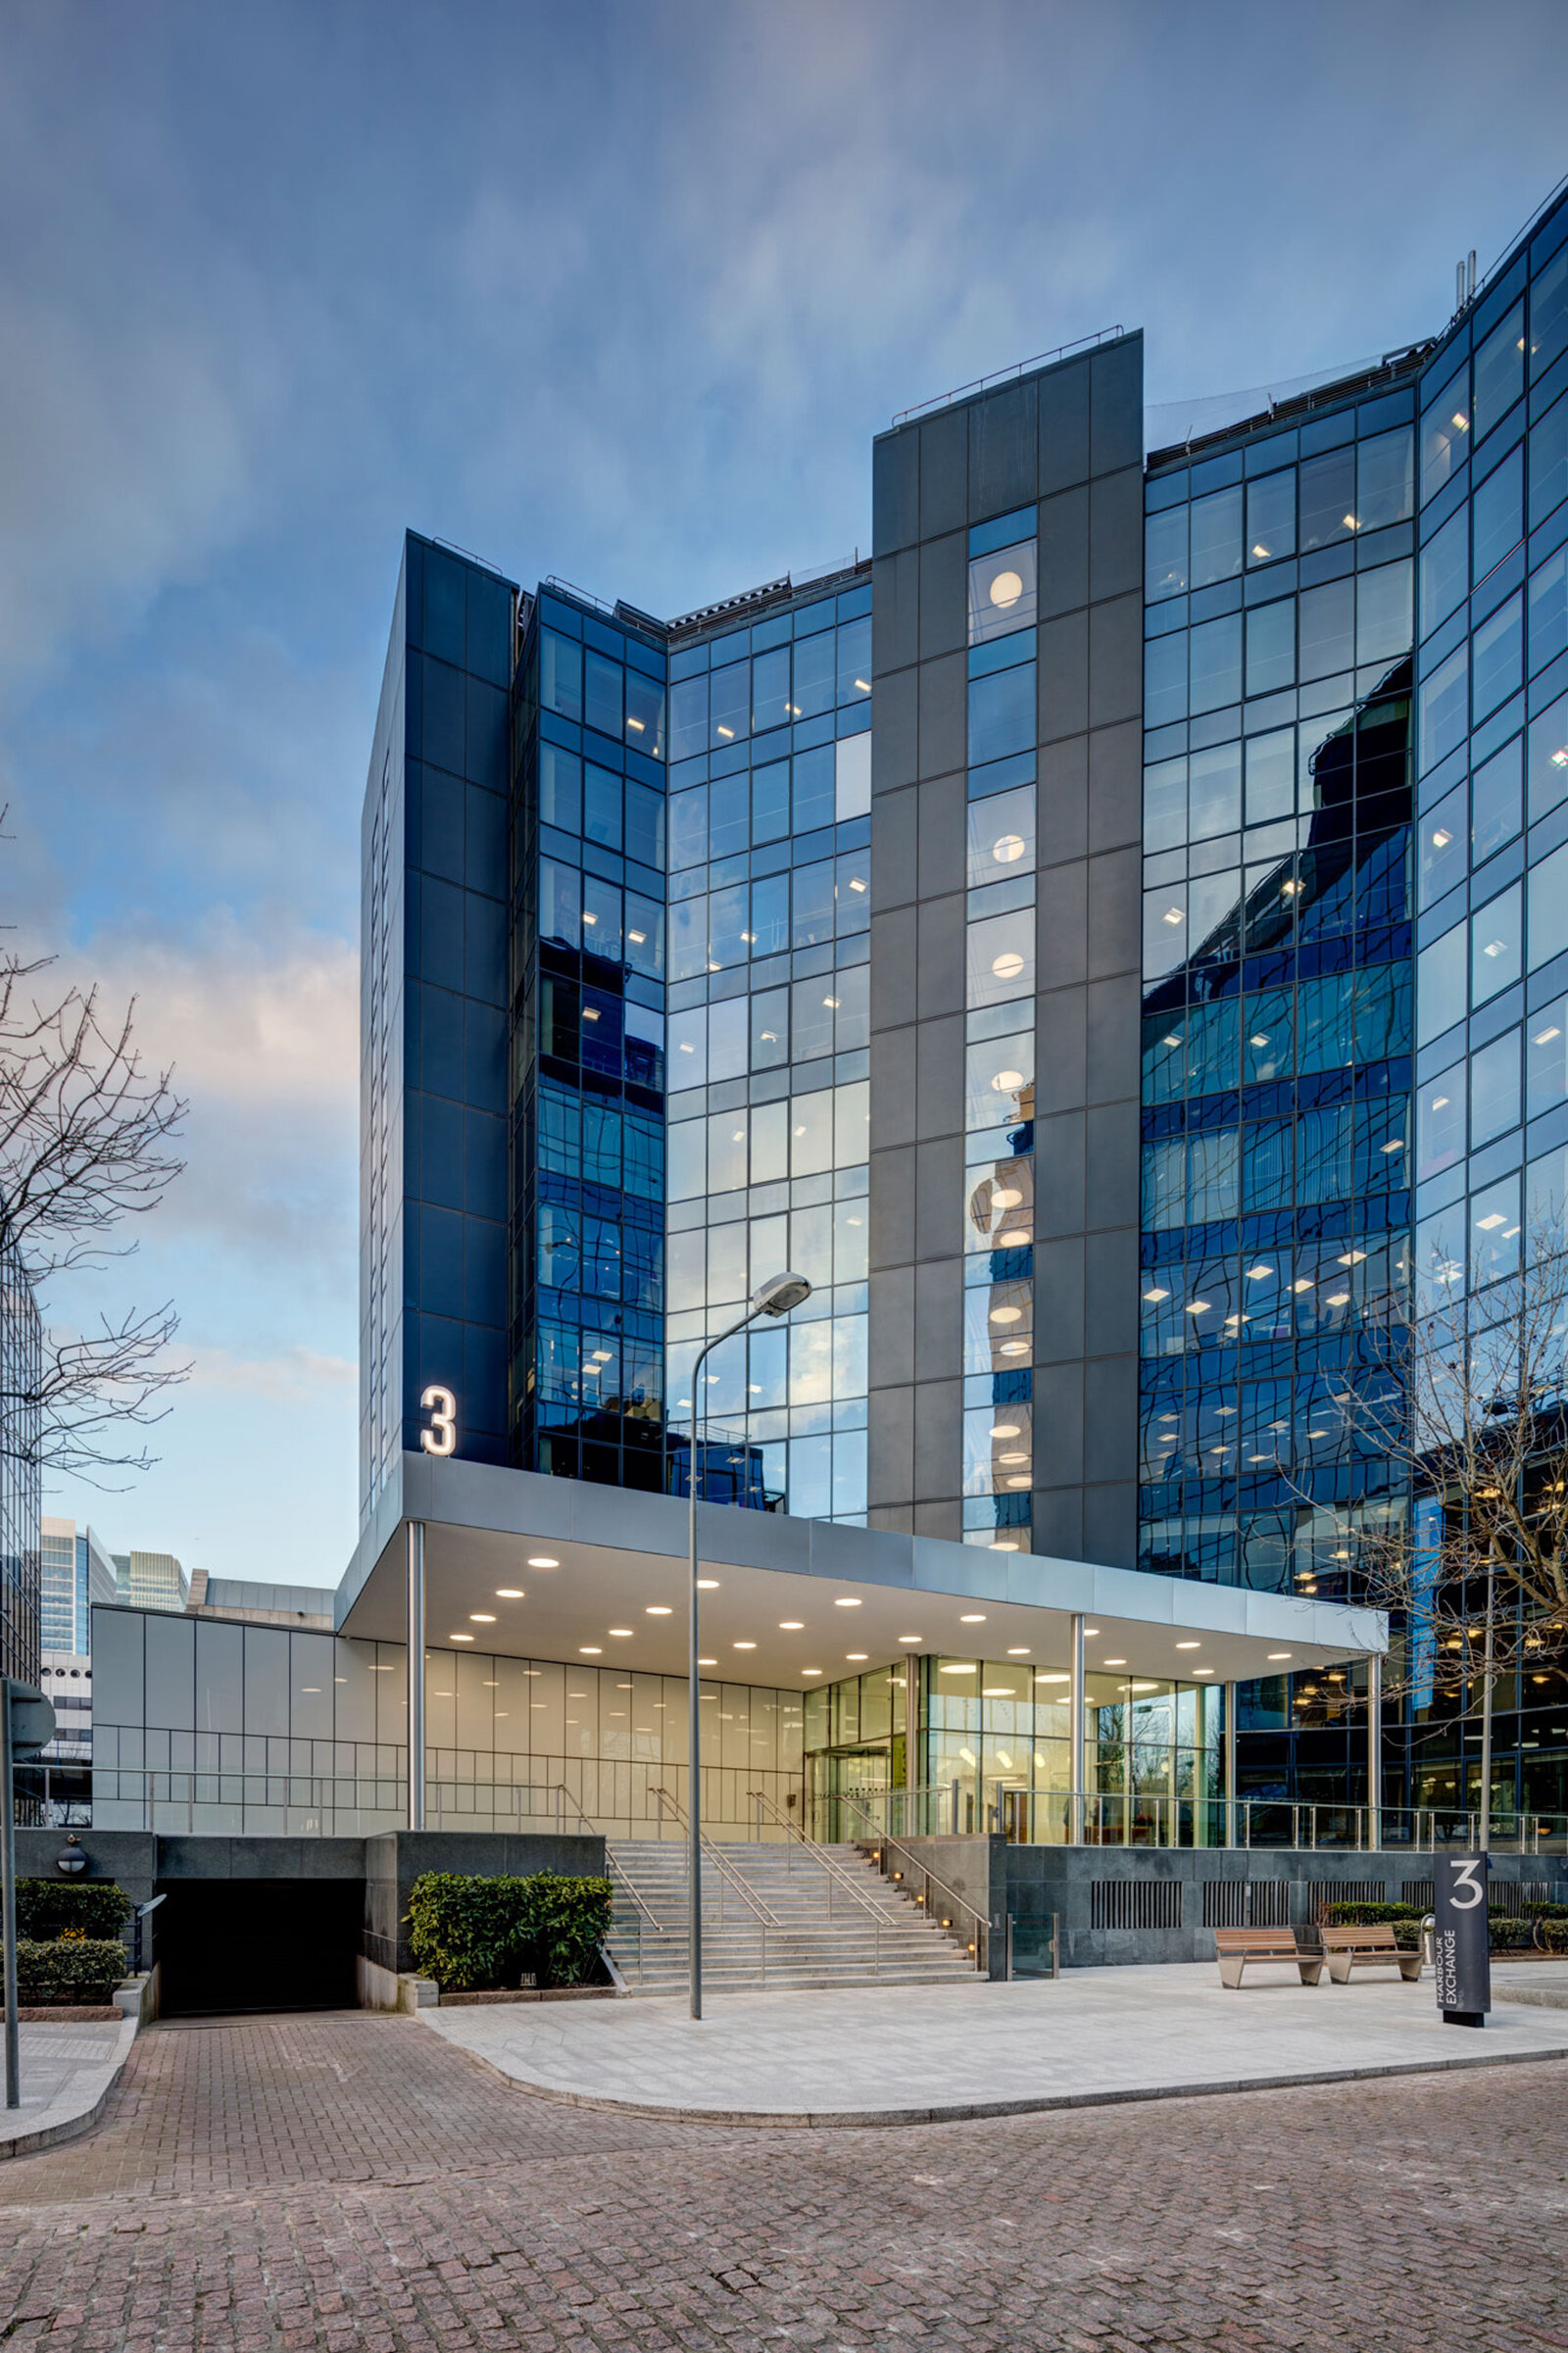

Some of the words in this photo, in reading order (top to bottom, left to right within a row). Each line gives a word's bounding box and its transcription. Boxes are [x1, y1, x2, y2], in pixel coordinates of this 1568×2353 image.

[419, 1385, 457, 1456] 3
[1449, 1860, 1484, 1909] 3
[1436, 1936, 1445, 2003] HARBOUR
[1444, 1930, 1457, 2005] EXCHANGE
